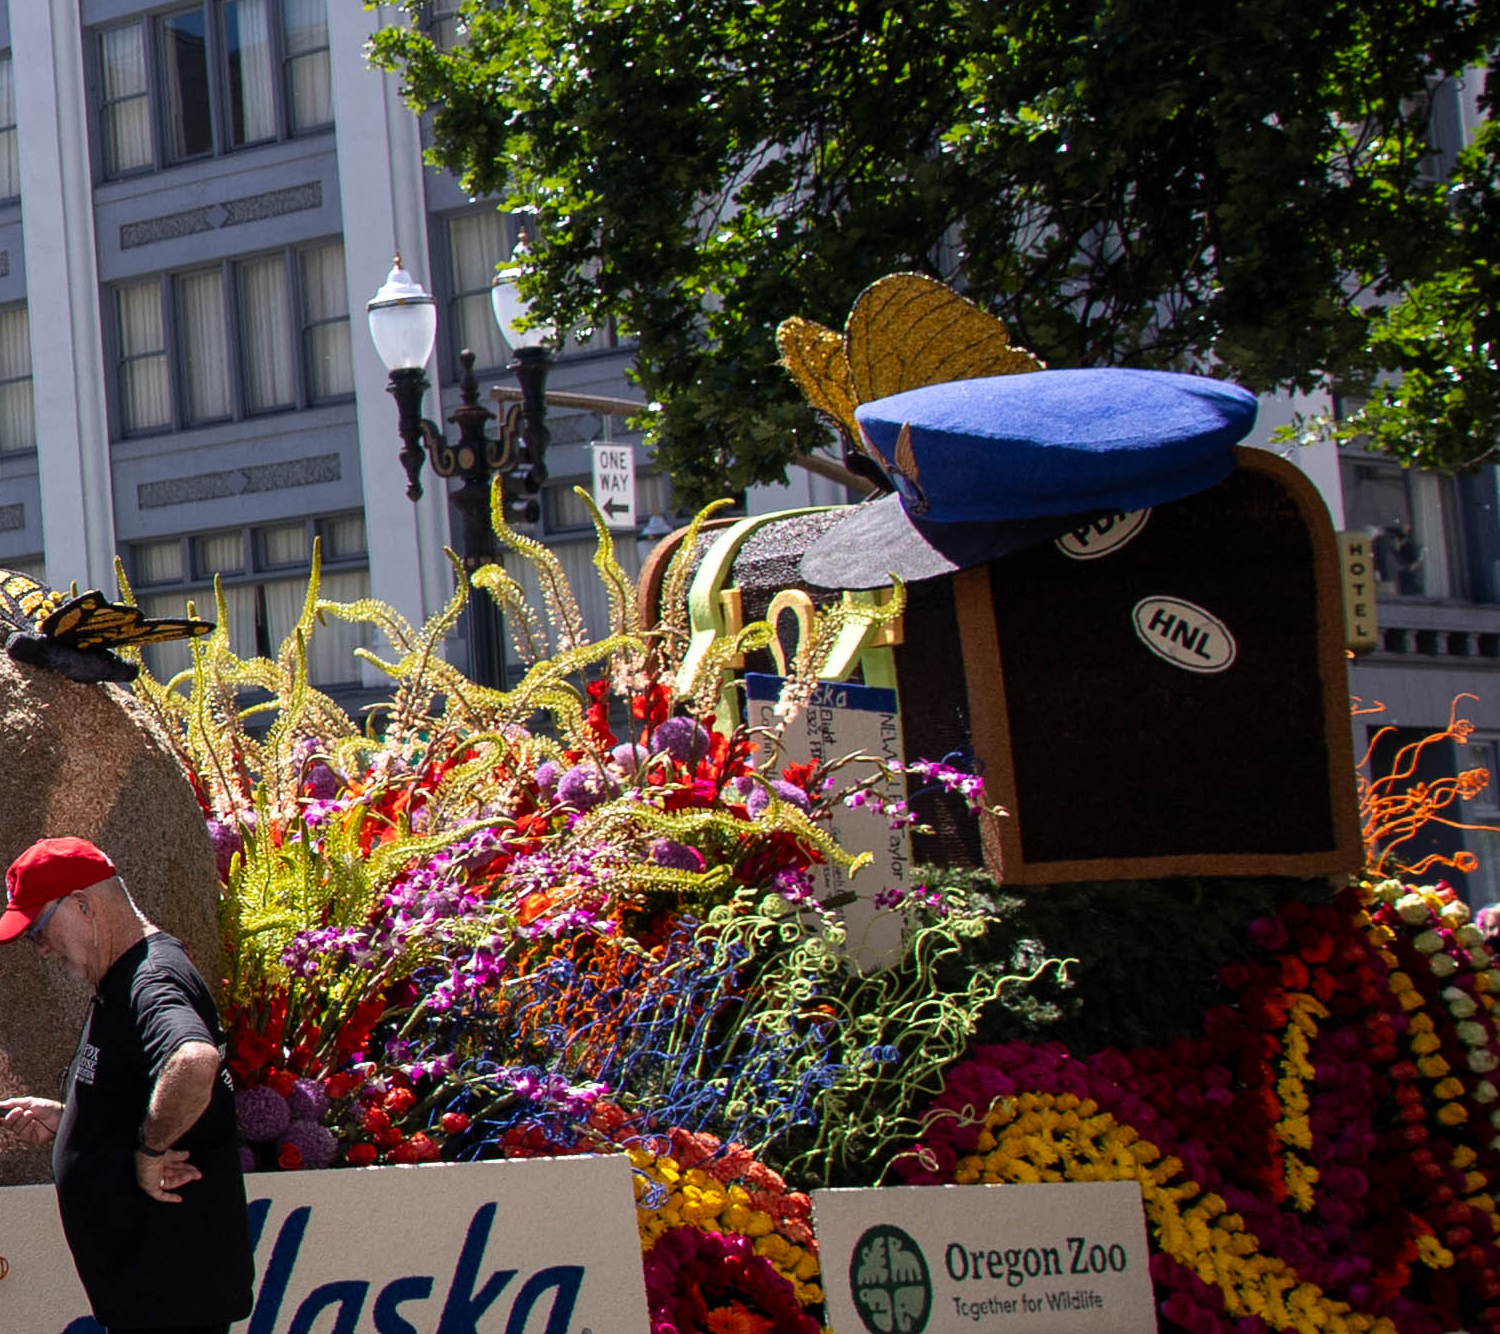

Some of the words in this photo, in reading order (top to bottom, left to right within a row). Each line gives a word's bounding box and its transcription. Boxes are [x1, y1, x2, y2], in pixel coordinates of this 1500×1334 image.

[600, 451, 627, 469] ONE
[599, 474, 628, 491] WAY
[1072, 512, 1128, 547] PD
[1350, 544, 1368, 637] HOTEL
[1148, 608, 1212, 661] HNL
[945, 1242, 1063, 1287] Oregon
[1066, 1237, 1127, 1275] Zoo
[952, 1296, 1018, 1321] Together
[1022, 1293, 1043, 1312] for
[1045, 1290, 1103, 1312] Wildlife
